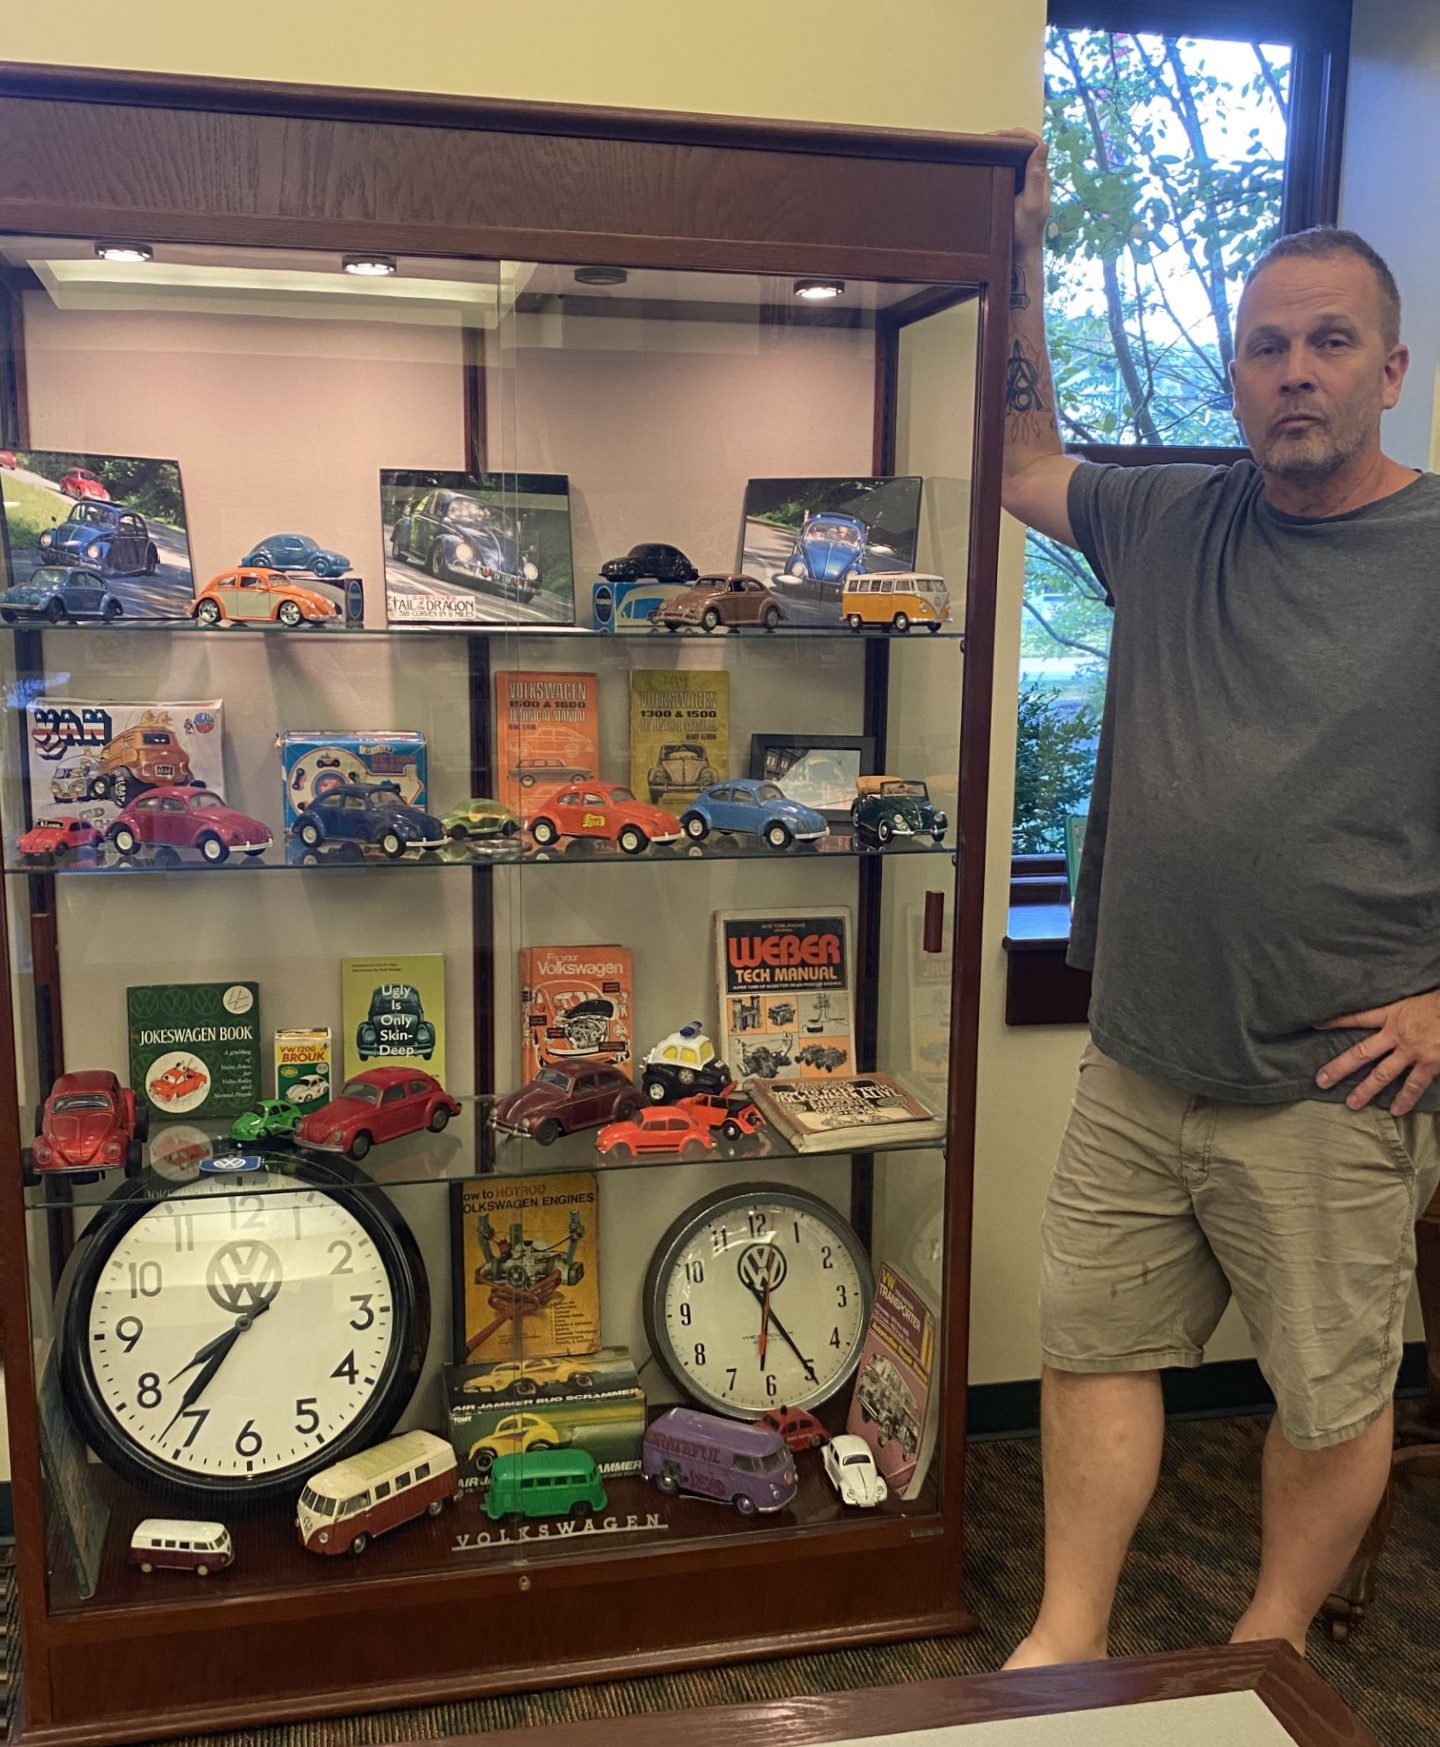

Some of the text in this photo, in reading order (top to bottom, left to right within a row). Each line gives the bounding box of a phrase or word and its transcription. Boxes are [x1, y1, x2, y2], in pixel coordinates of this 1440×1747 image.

[391, 596, 416, 611] TAIL
[426, 600, 475, 611] DRAGON
[509, 681, 586, 699] VOLKSWAGEN
[641, 691, 717, 709] VOLKSWAGEN
[641, 710, 671, 718] 1300
[687, 710, 717, 718] 1500
[729, 933, 840, 967] WEBER
[537, 962, 623, 977] Volkswagen
[735, 966, 838, 983] TECH MANUAL
[382, 984, 411, 998] Ugly
[391, 1000, 402, 1010] Is
[381, 1015, 412, 1028] Only
[139, 1026, 253, 1046] JOKESWAGEN BOOK
[380, 1029, 413, 1041] Skin-
[282, 1051, 325, 1062] BROUK
[297, 1045, 316, 1053] 1200
[379, 1045, 414, 1057] Deep
[862, 1088, 903, 1099] ALIVE
[463, 1184, 546, 1201] ow to HOTROD
[463, 1192, 594, 1214] OLKSWAGEN ENGINES
[228, 1194, 267, 1231] 12
[292, 1206, 301, 1240] 1
[173, 1215, 195, 1252] 11
[748, 1213, 766, 1238] 12
[793, 1221, 800, 1243] 1
[712, 1228, 728, 1252] 11
[327, 1240, 354, 1275] 2
[821, 1246, 833, 1269] 2
[129, 1261, 162, 1298] 10
[685, 1260, 705, 1283] 10
[881, 1268, 897, 1290] VW
[836, 1285, 847, 1308] 3
[879, 1282, 922, 1333] TRANSPORTER
[350, 1294, 374, 1331] 3
[680, 1303, 691, 1325] 9
[116, 1316, 143, 1353] 9
[828, 1327, 841, 1349] 4
[694, 1343, 706, 1365] 8
[330, 1349, 359, 1384] 4
[726, 1368, 737, 1390] 7
[765, 1374, 777, 1396] 6
[137, 1372, 162, 1409] 8
[452, 1388, 640, 1412] AIR JAMMER BUG SCRAMMER
[295, 1398, 319, 1434] 5
[453, 1415, 472, 1423] TOMY
[182, 1409, 210, 1447] 7
[235, 1420, 262, 1457] 6
[645, 1432, 721, 1464] GRATEFUL
[597, 1460, 642, 1473] AMMER
[456, 1513, 660, 1548] VOLKSWAGEN
